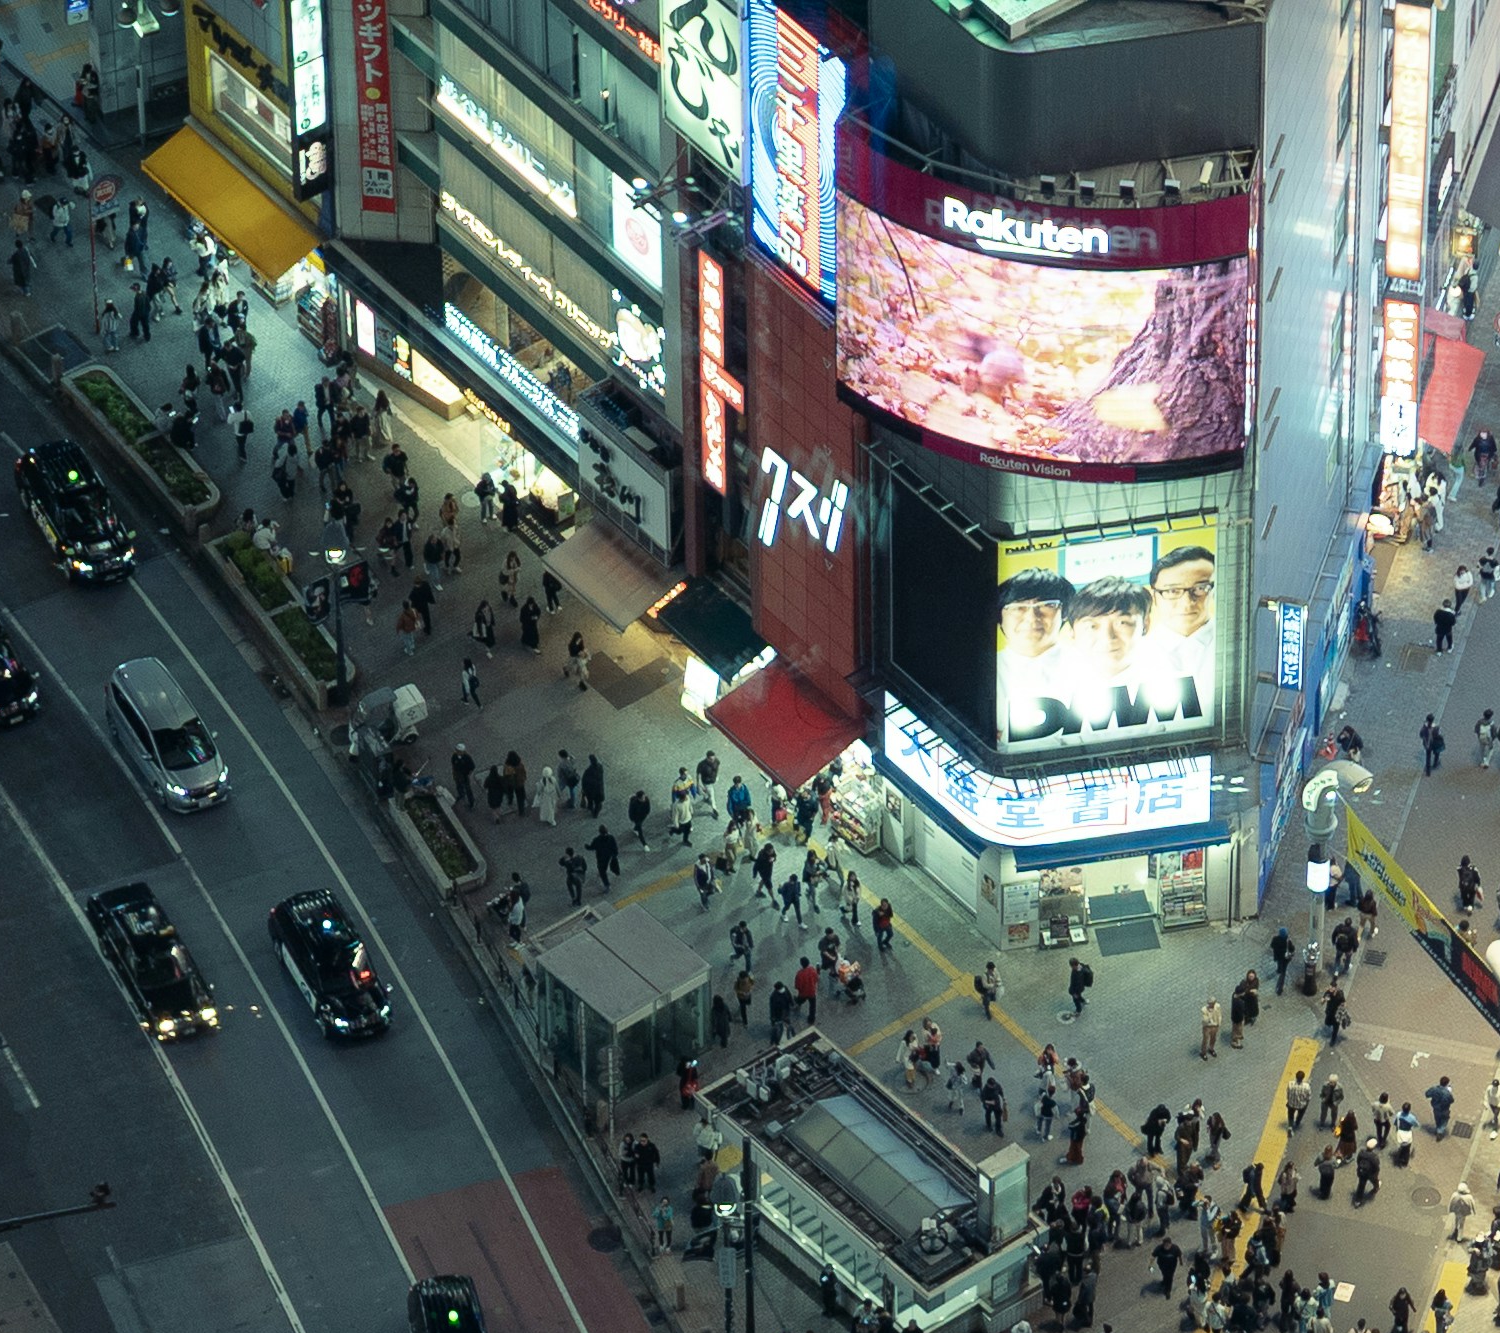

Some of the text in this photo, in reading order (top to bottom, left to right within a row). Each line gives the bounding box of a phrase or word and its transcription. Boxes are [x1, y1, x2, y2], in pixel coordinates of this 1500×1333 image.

[775, 33, 810, 277] 三千里薬品
[943, 196, 1109, 253] Rakuten
[980, 453, 1071, 477] Rakuten Vision
[1007, 675, 1203, 743] DMM
[901, 728, 1194, 829] 大盛堂書店
